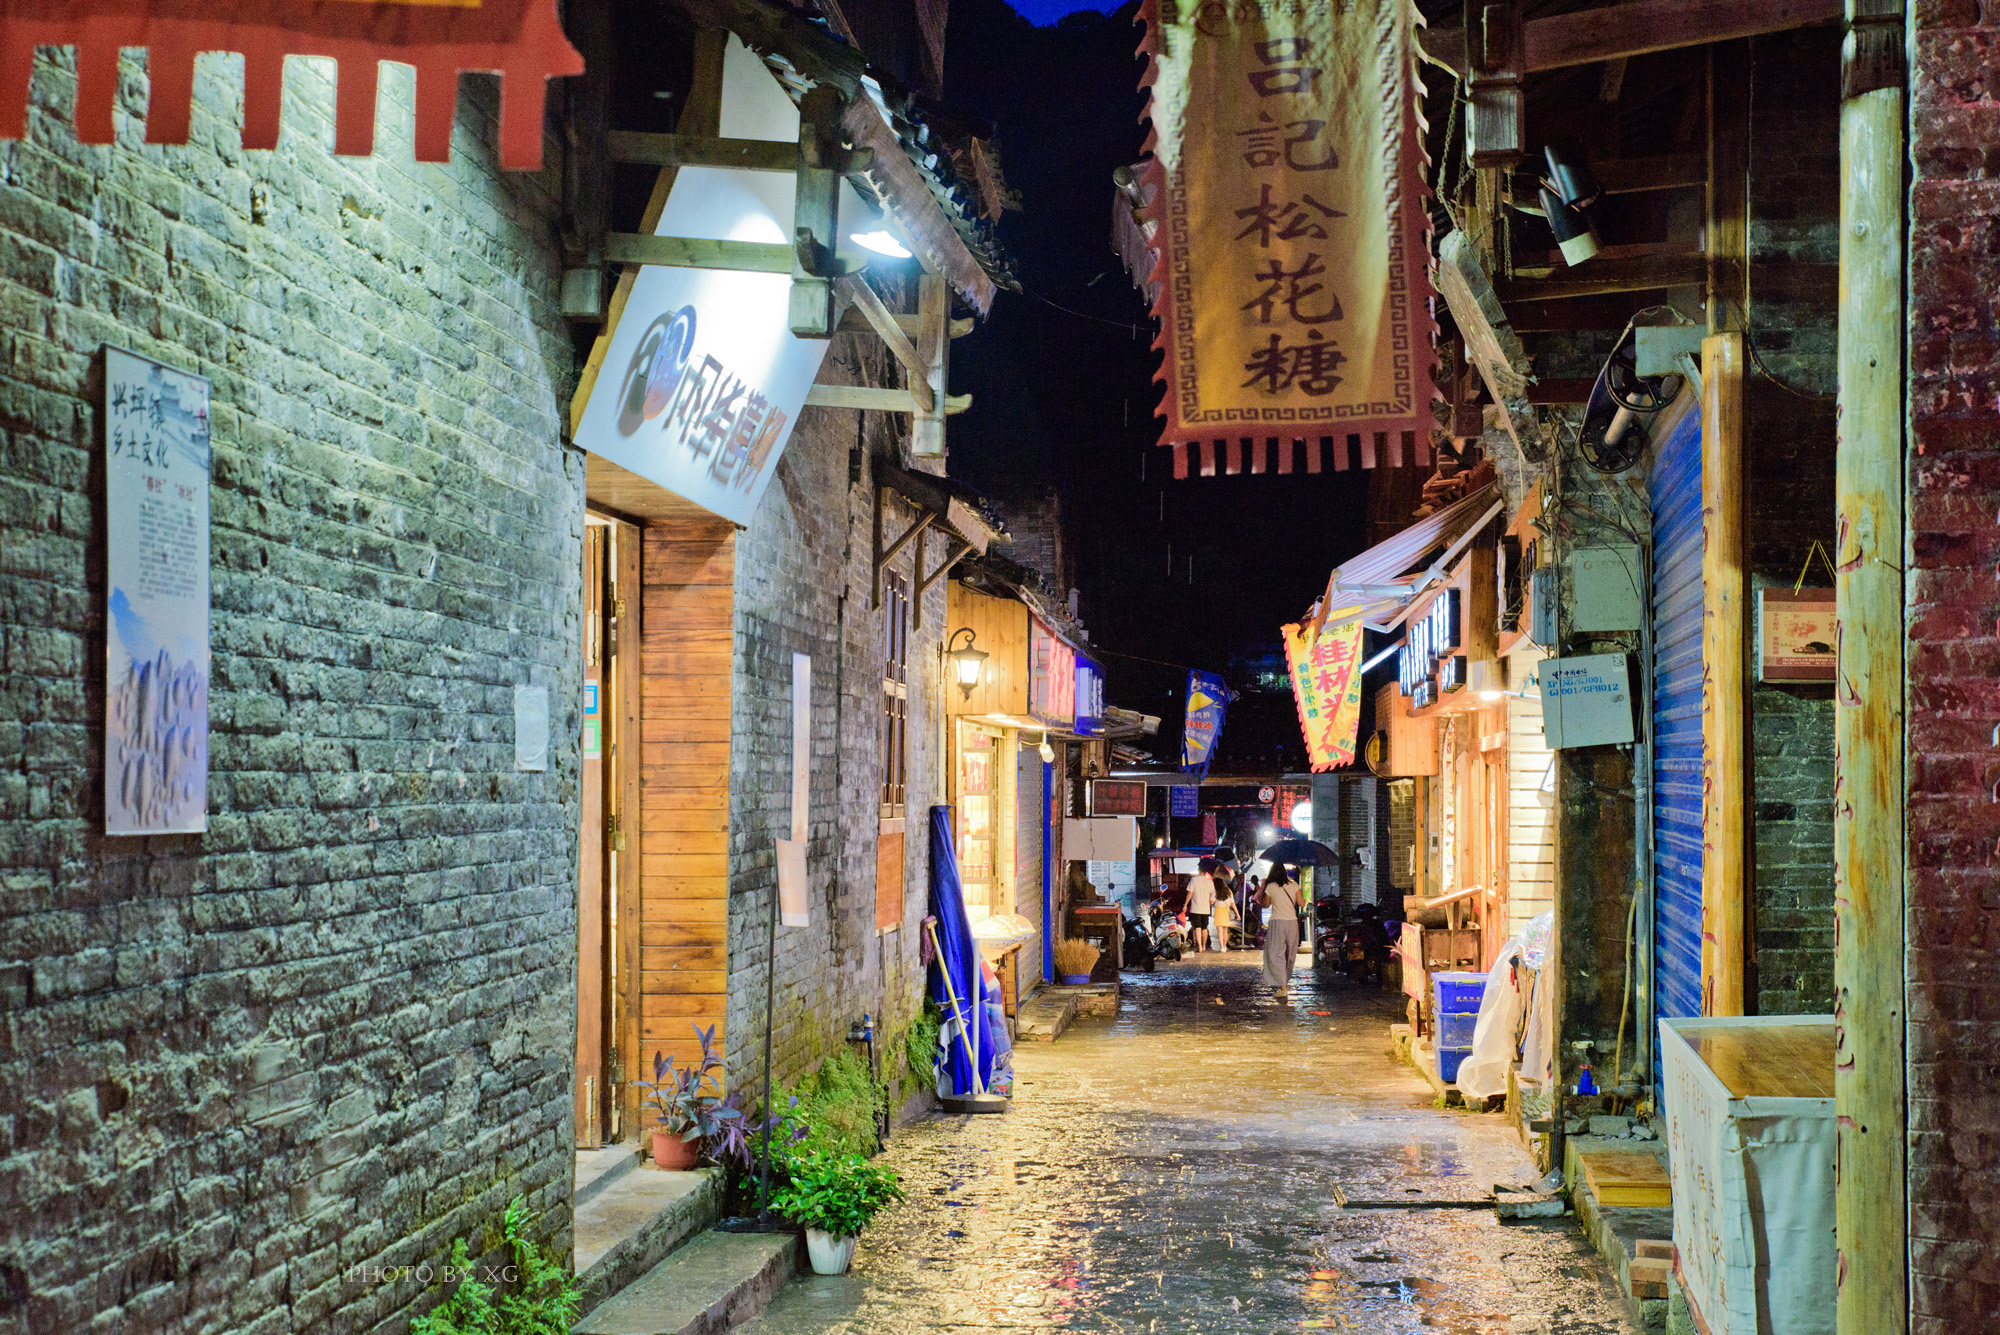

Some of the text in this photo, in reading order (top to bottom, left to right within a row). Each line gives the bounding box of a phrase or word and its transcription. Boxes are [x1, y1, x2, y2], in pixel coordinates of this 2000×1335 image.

[112, 423, 169, 469] 乡土文化
[1563, 667, 1588, 677] 中国电信
[1547, 675, 1603, 688] XPNG/GJ001
